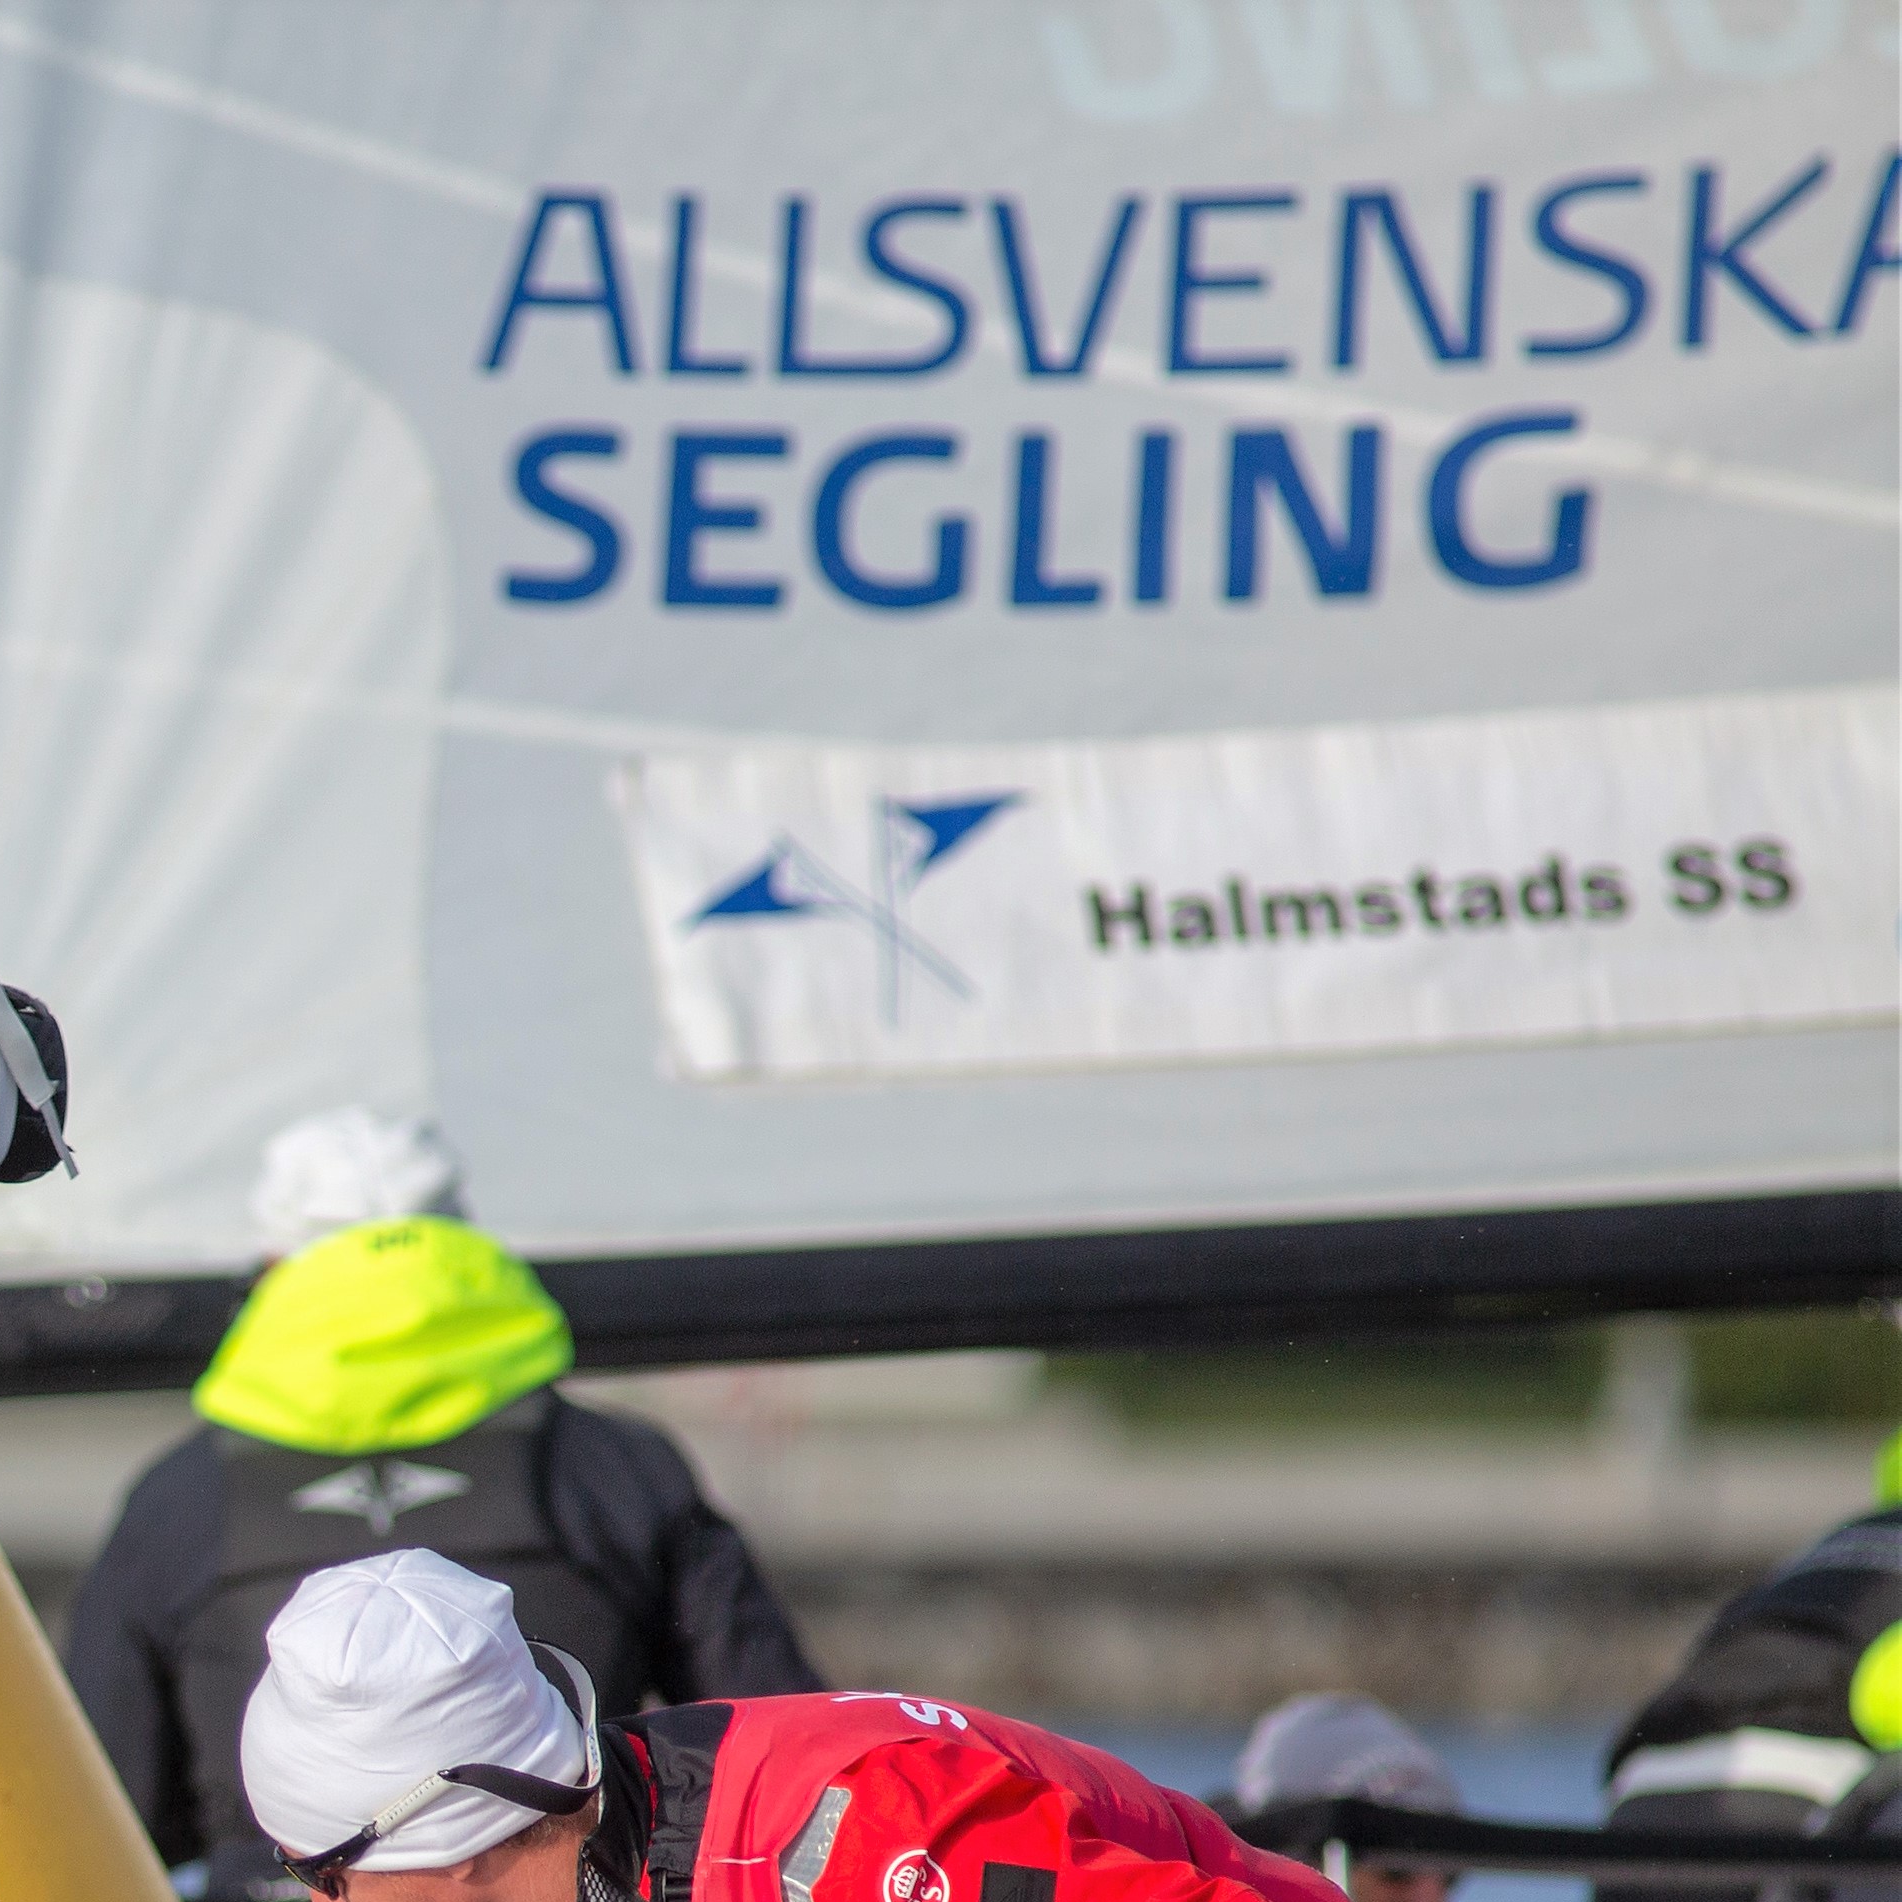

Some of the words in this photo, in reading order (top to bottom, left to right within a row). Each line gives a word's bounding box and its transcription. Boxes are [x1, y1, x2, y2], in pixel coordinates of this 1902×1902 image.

[498, 408, 1597, 611] SEGLING
[1085, 848, 1631, 953] Halmstads
[1665, 838, 1797, 915] SS
